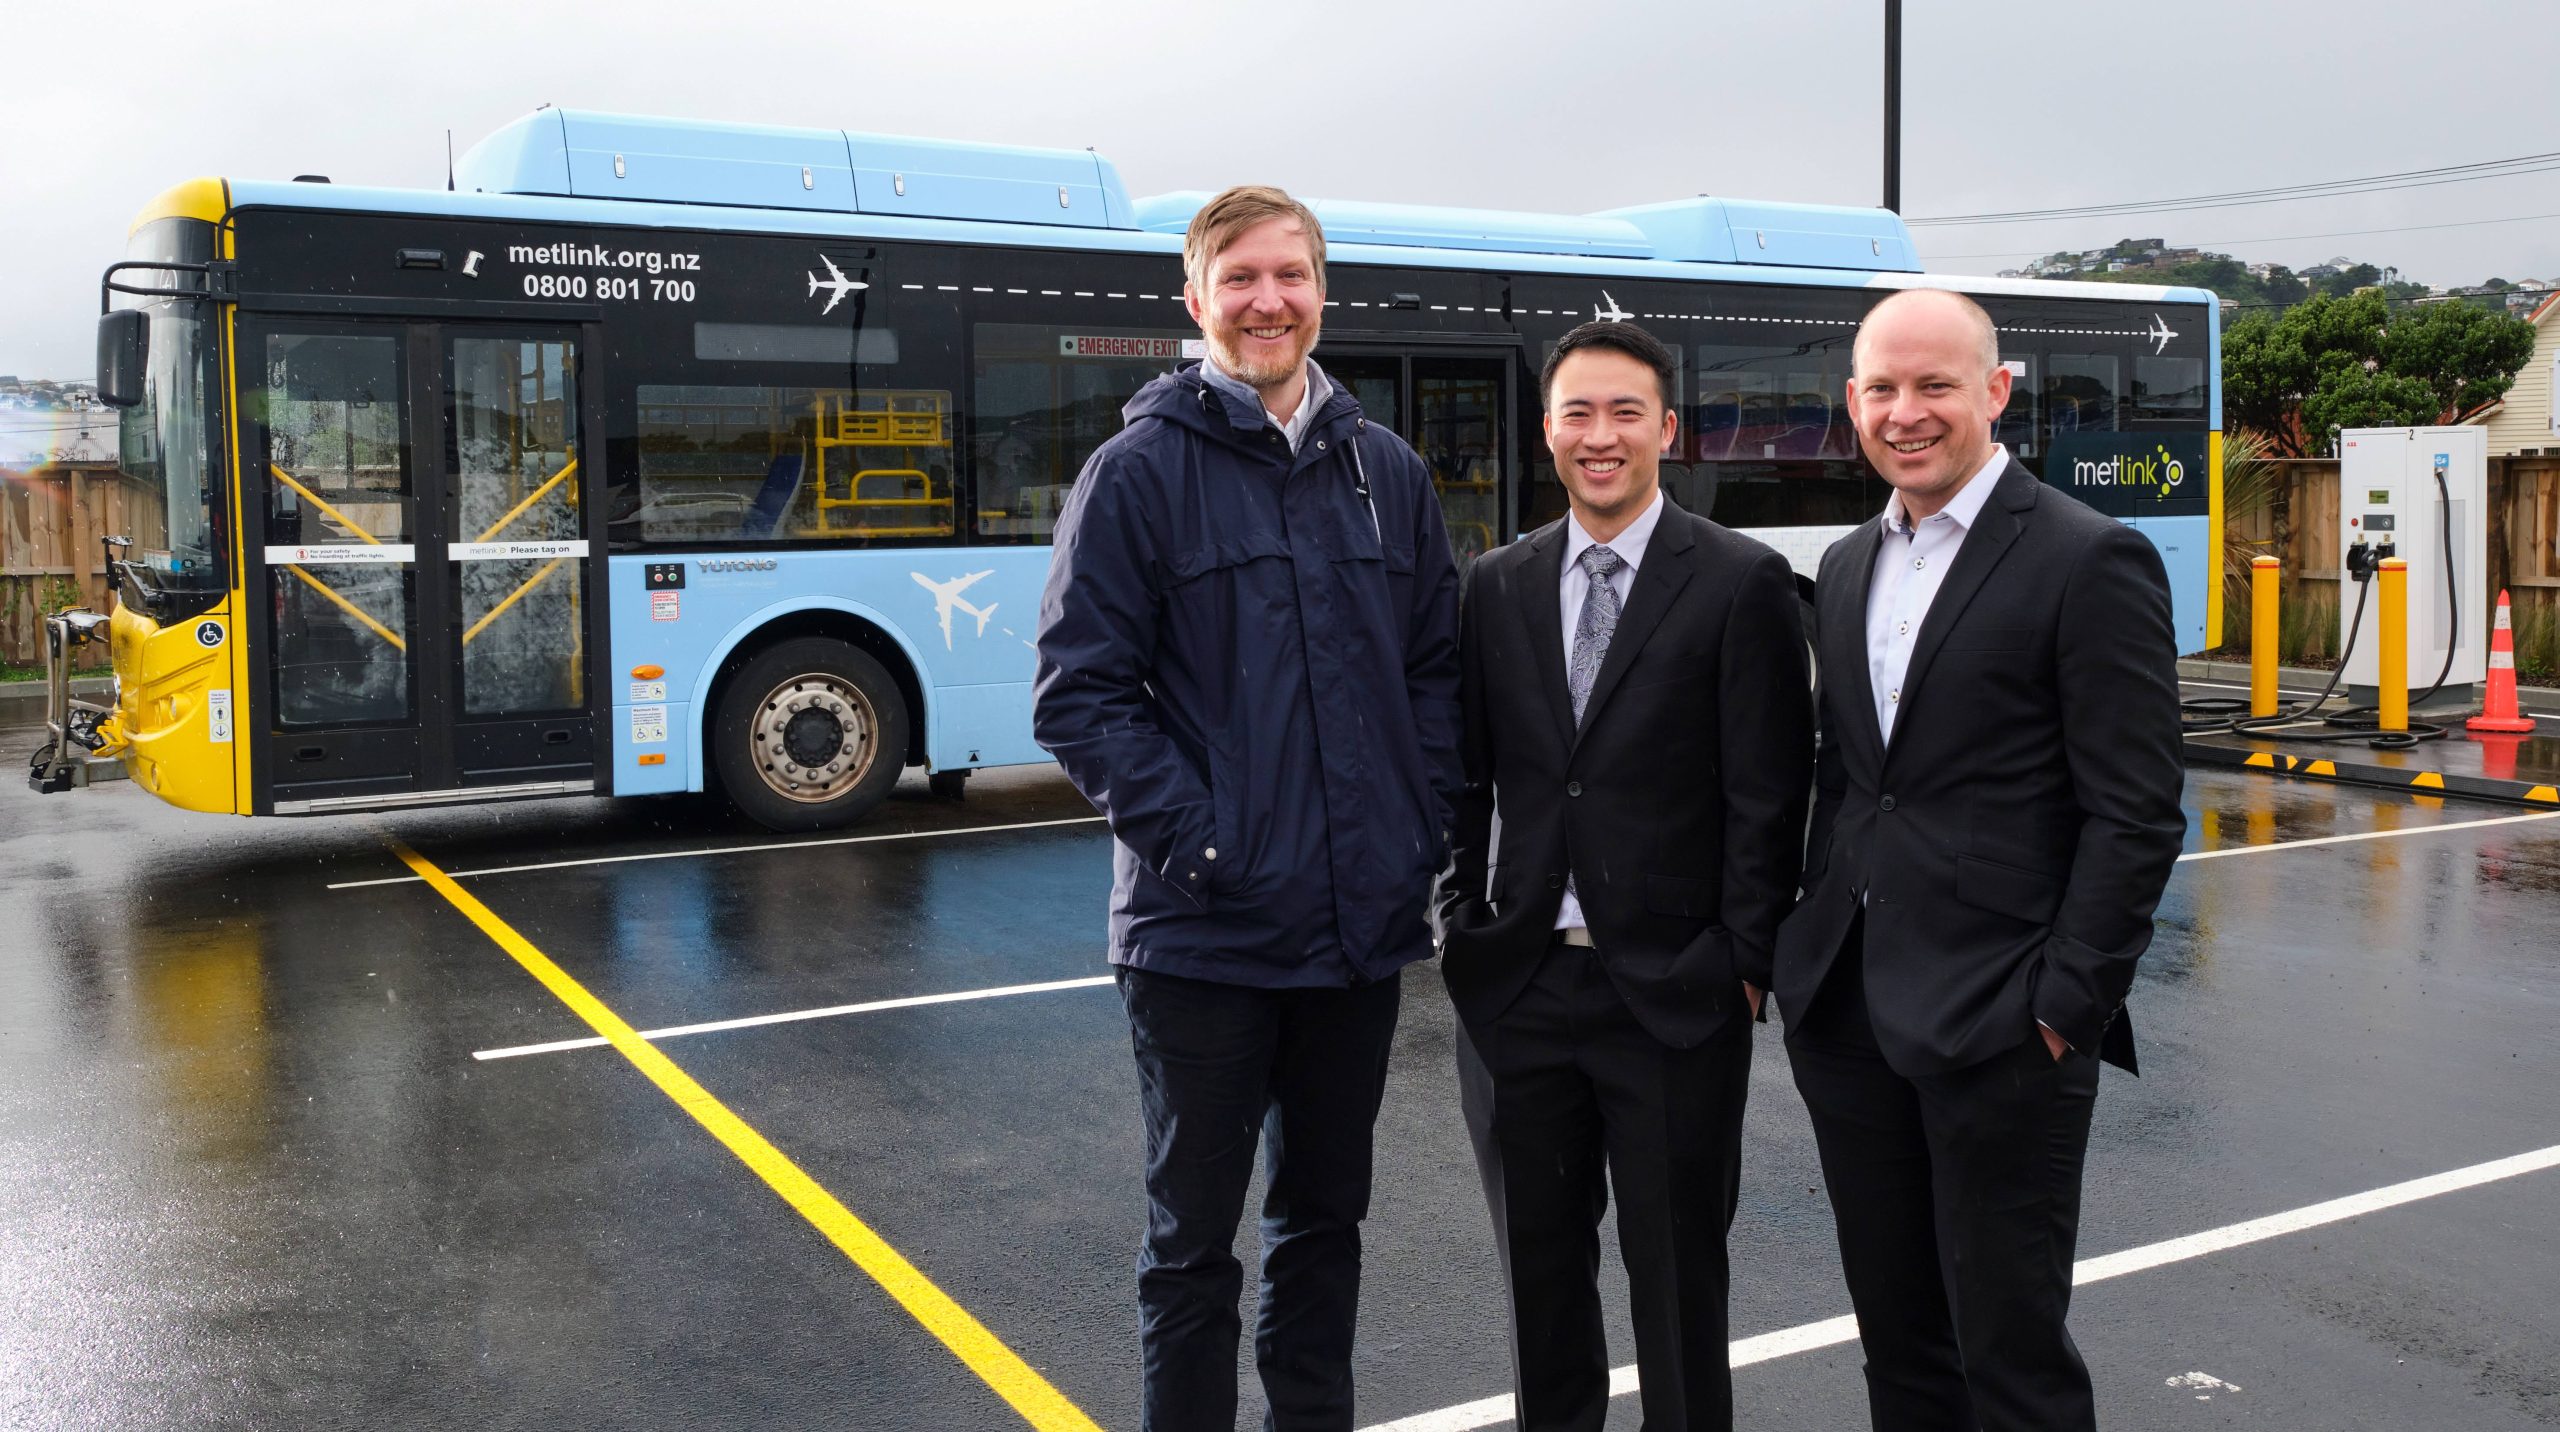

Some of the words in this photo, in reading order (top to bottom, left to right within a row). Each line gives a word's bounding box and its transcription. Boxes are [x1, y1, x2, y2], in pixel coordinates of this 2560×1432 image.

[508, 242, 701, 274] metlink.org.nz
[523, 274, 588, 299] 0800
[595, 276, 640, 300] 801
[649, 279, 696, 302] 700
[1077, 336, 1150, 356] EMERGENCY
[1152, 339, 1179, 357] EXIT
[2408, 429, 2414, 441] 2
[2074, 454, 2158, 486] metlink
[510, 546, 539, 554] Please
[541, 546, 556, 555] tag
[558, 545, 570, 553] on
[696, 559, 778, 574] YUTONG
